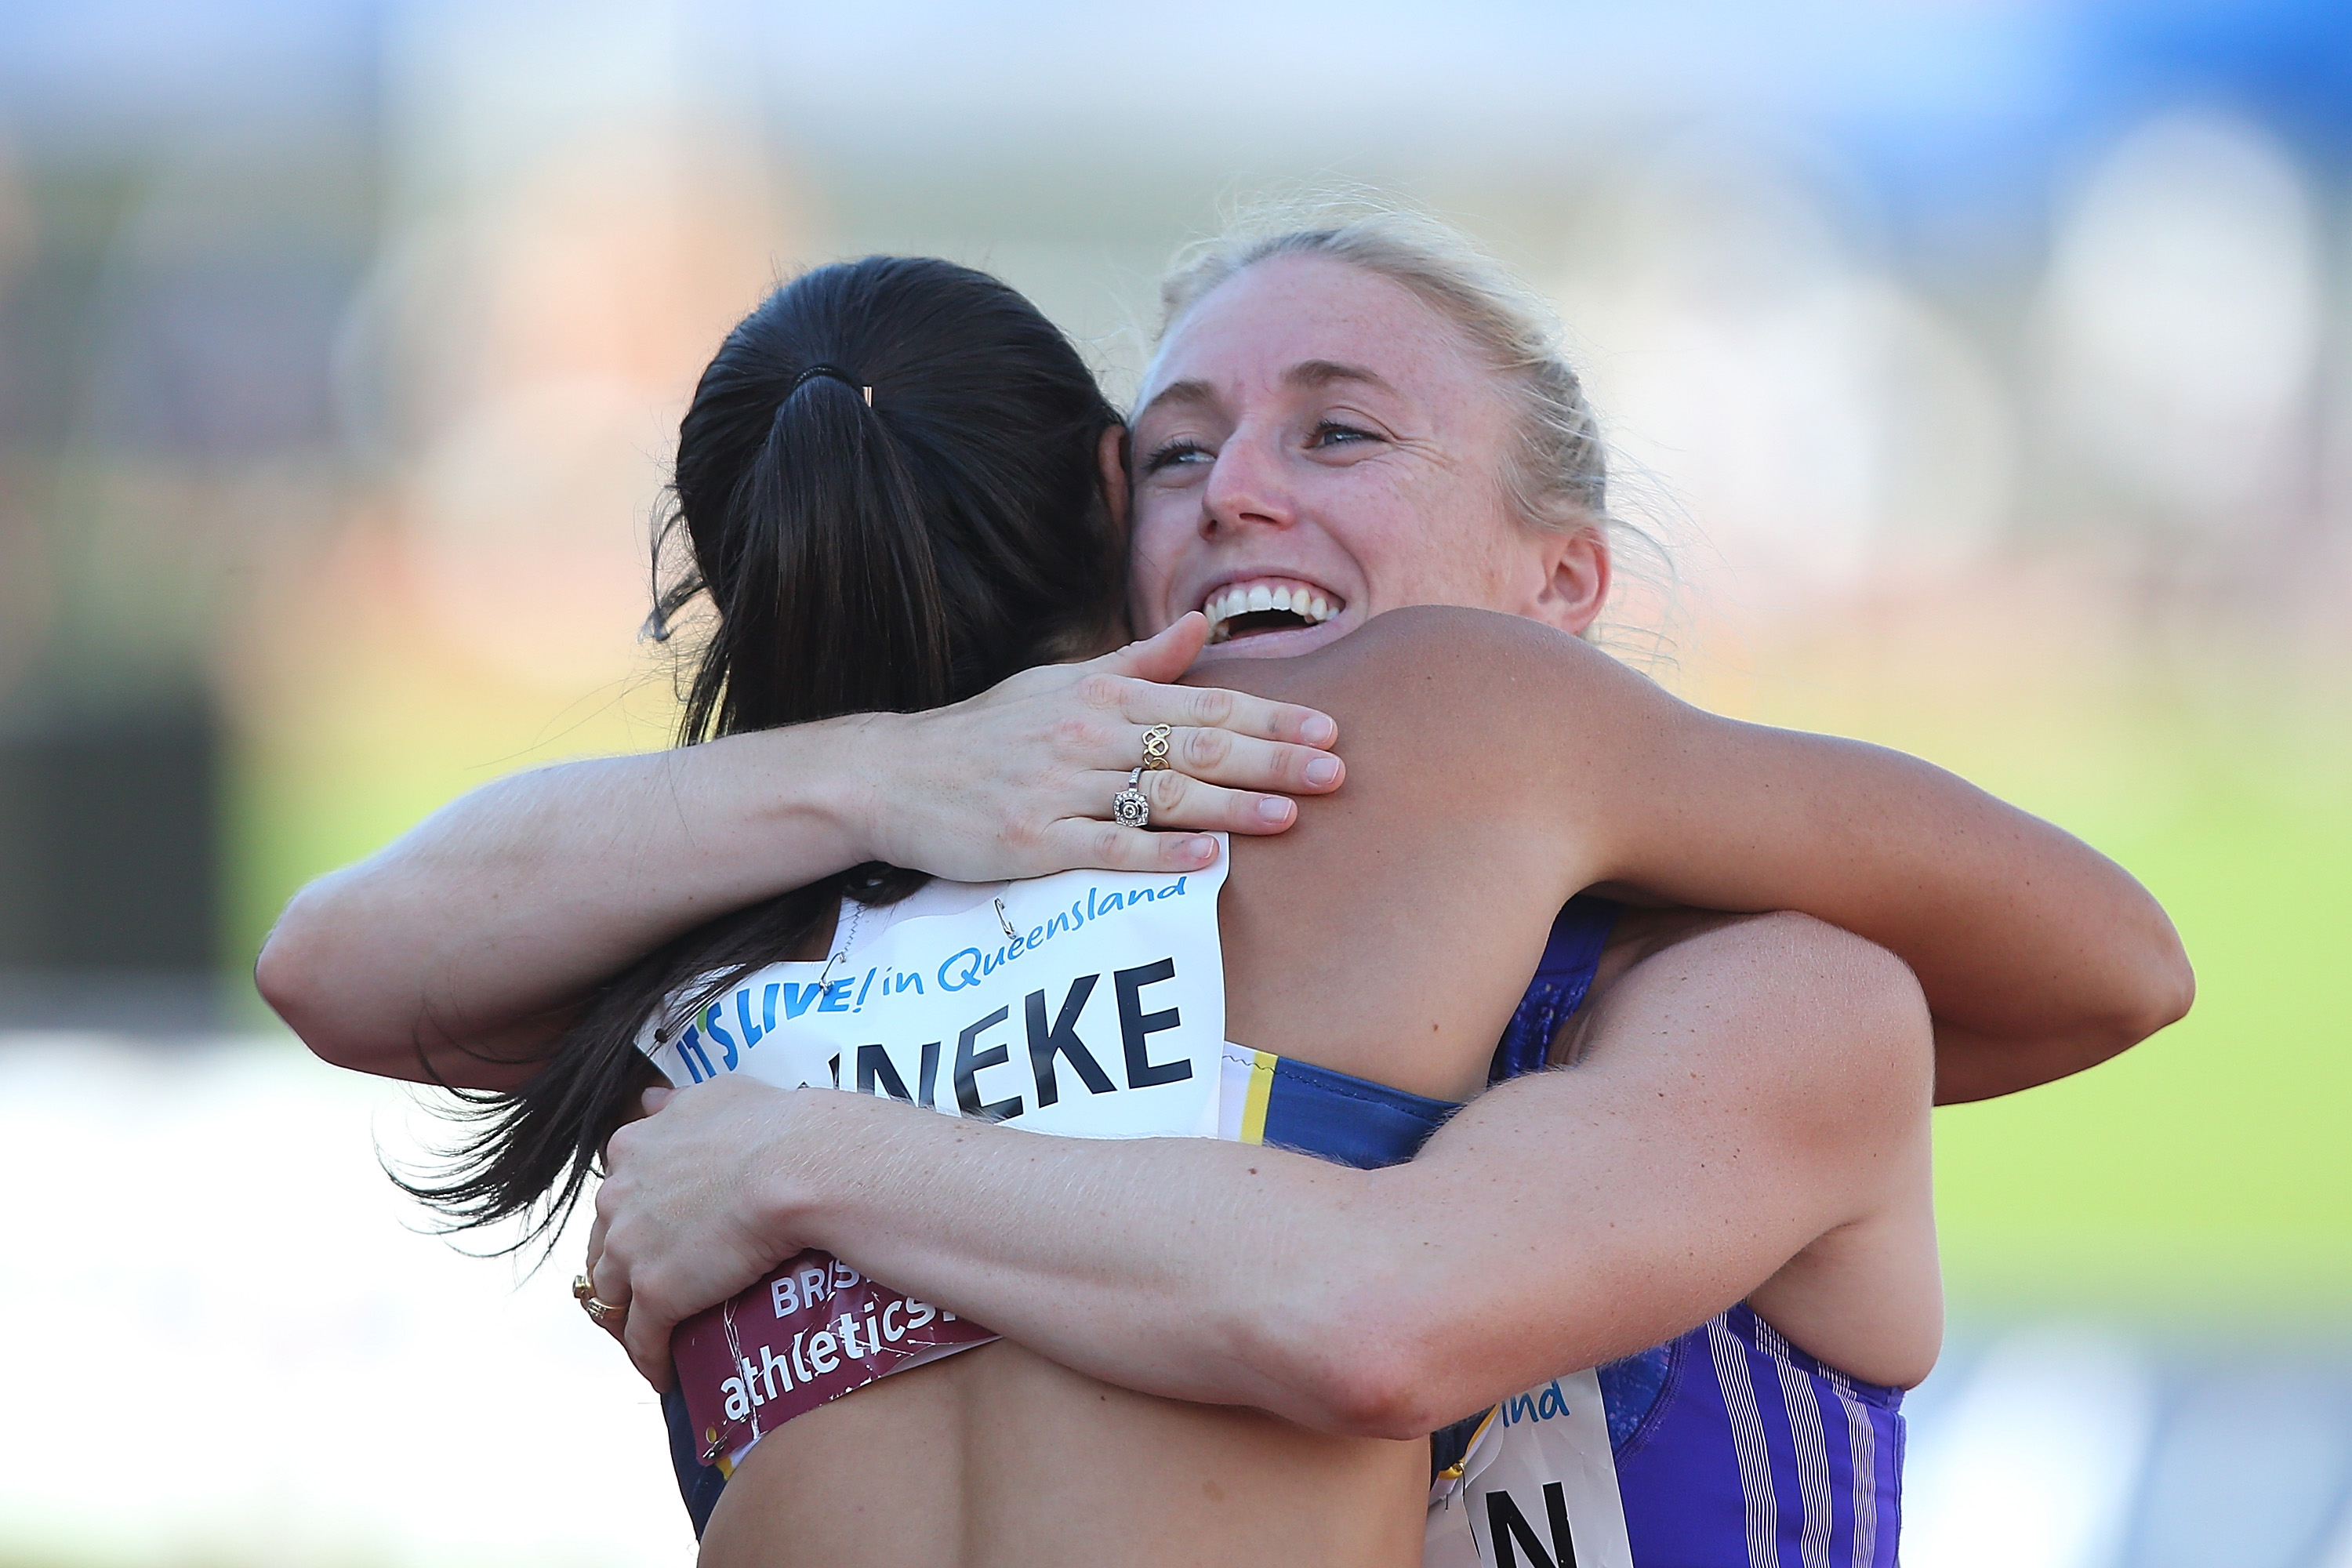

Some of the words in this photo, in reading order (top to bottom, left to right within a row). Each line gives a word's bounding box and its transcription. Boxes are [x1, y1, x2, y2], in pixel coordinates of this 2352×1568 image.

[676, 1002, 739, 1083] IT'S
[736, 967, 877, 1048] LIVE!
[883, 967, 924, 995] in
[937, 876, 1187, 993] Queensland
[797, 957, 1193, 1124] NEKE
[771, 1260, 873, 1319] BRIS
[1468, 1482, 1578, 1568] N
